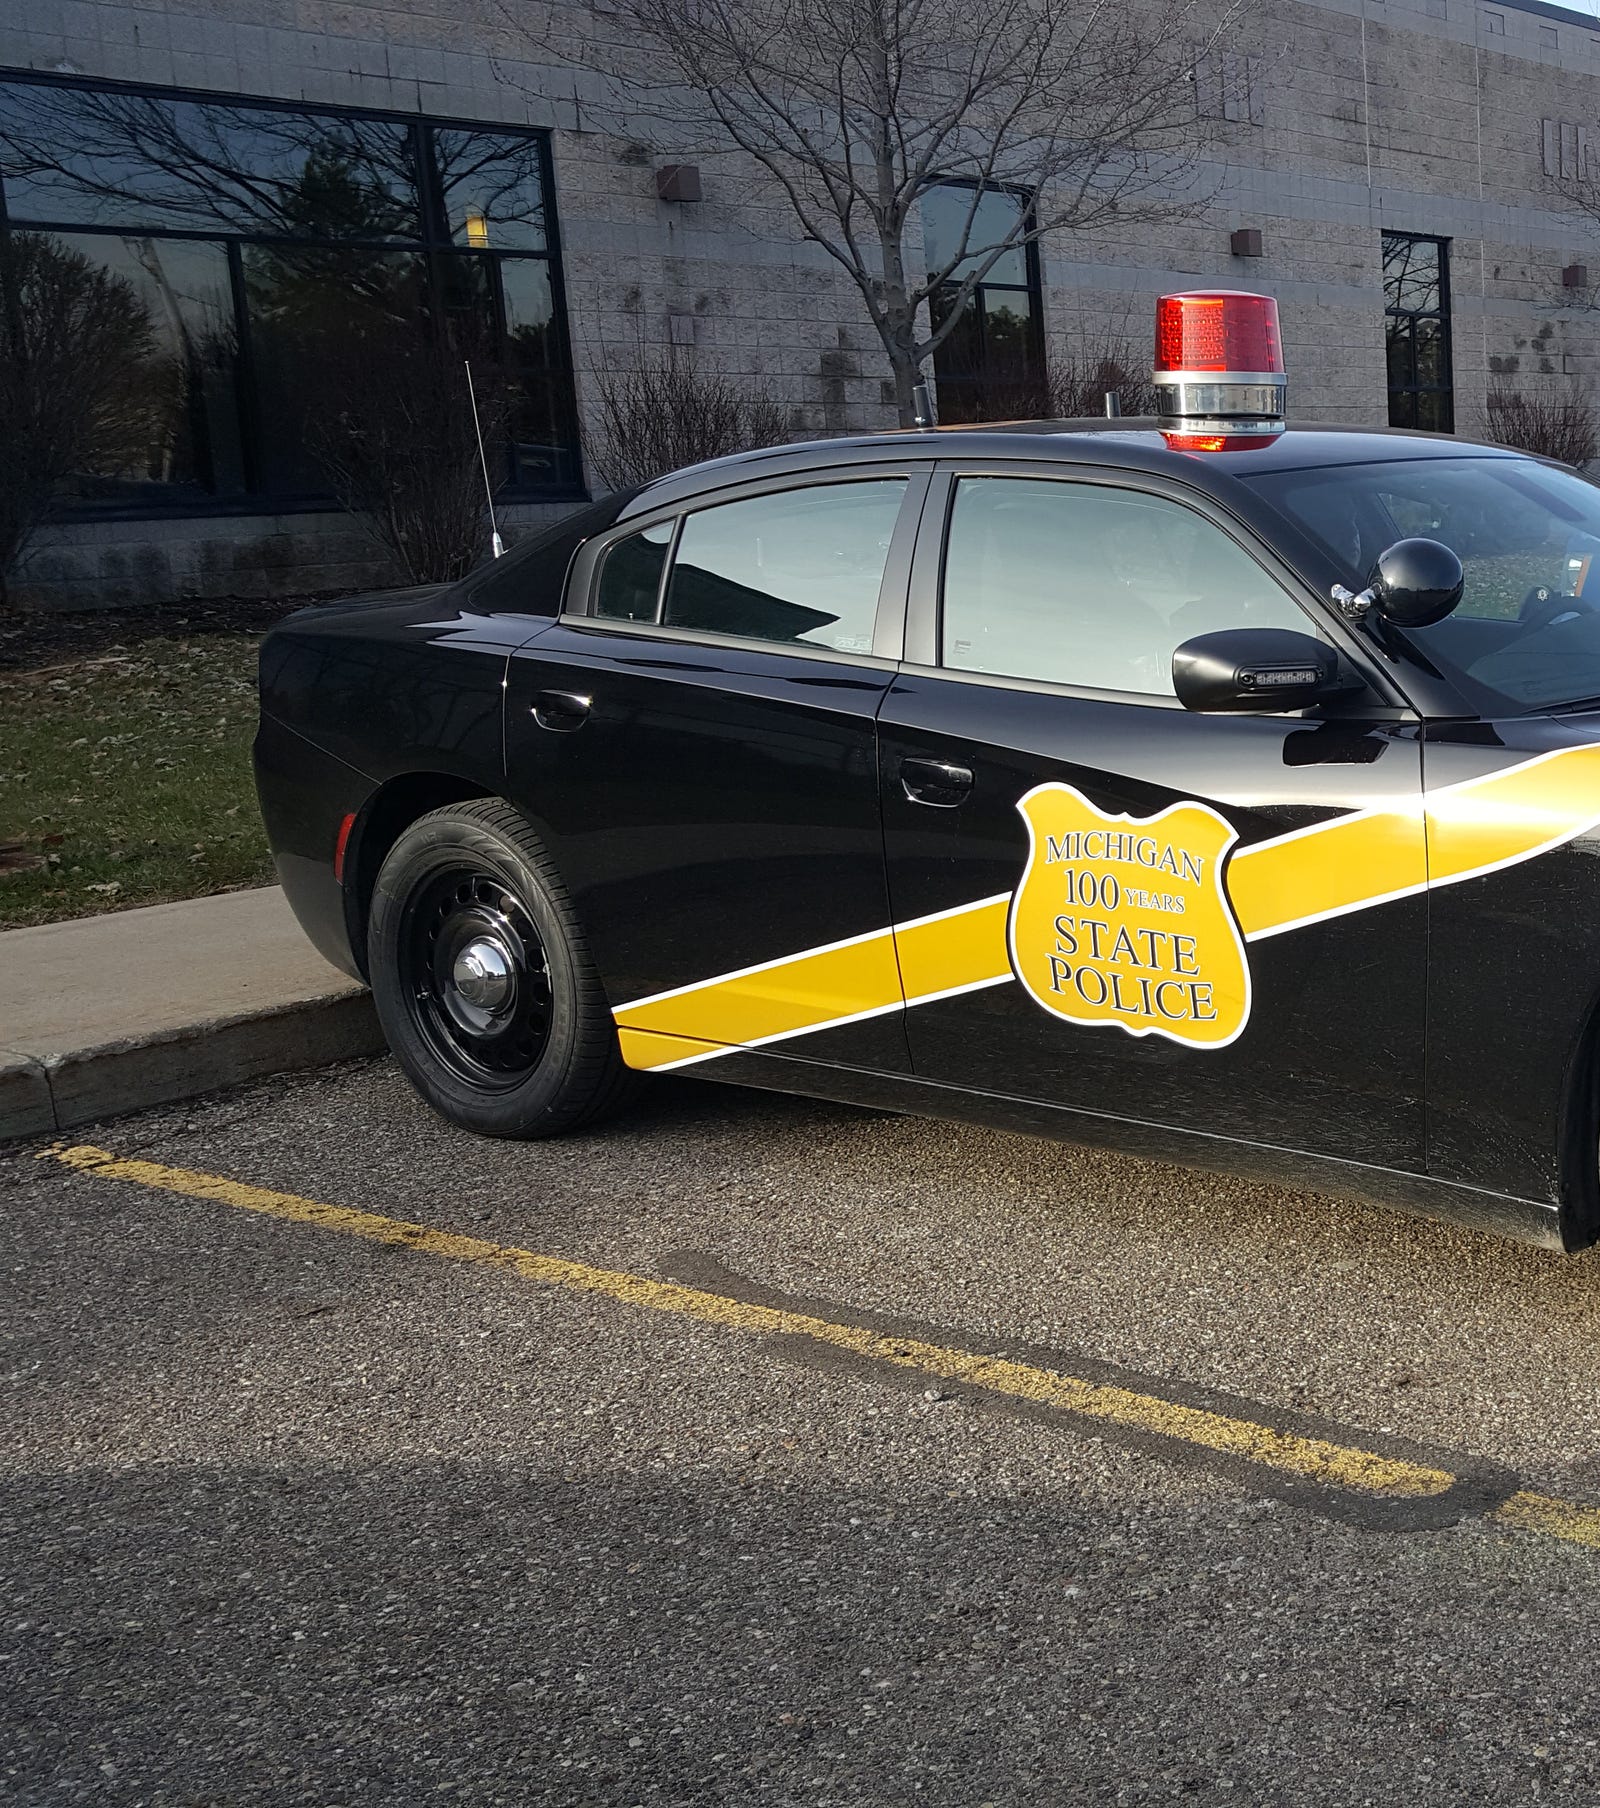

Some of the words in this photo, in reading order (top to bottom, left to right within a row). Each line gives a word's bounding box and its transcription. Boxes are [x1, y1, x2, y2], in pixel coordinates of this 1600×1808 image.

[1046, 831, 1203, 885] MICHIGAN
[1065, 868, 1120, 910] 100
[1125, 888, 1185, 913] YEARS
[1055, 915, 1200, 975] STATE
[1046, 954, 1218, 1021] POLICE
